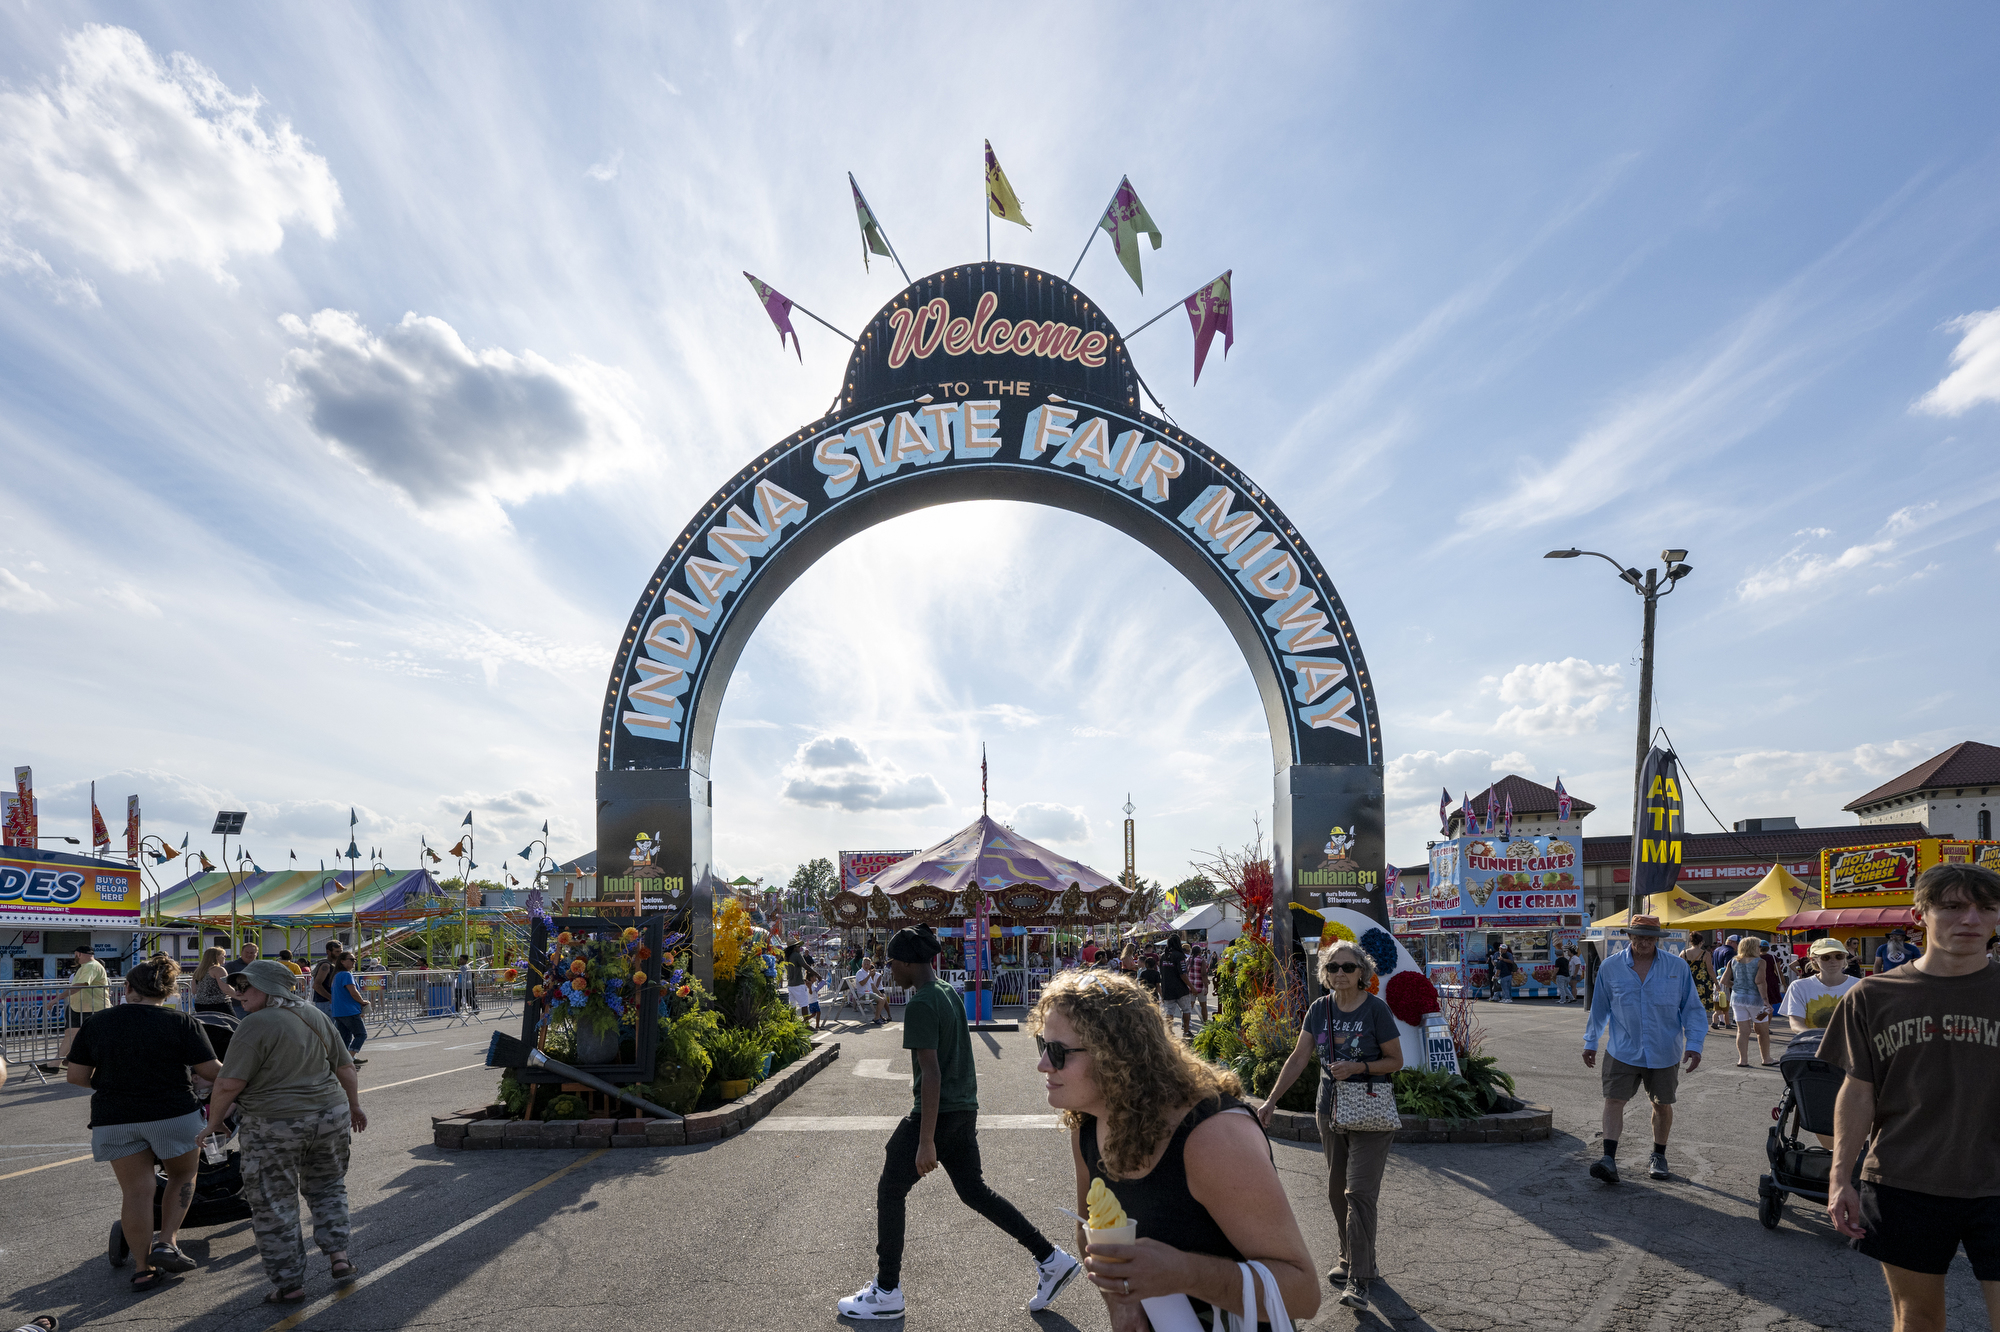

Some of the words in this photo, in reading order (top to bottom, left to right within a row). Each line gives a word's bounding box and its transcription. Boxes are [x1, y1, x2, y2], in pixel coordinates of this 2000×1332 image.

[888, 291, 1107, 369] Welcome
[938, 382, 970, 397] TO
[983, 380, 1030, 397] THE
[622, 478, 808, 742] INDIANA
[813, 400, 1002, 499] STATE
[1020, 404, 1185, 503] FAIR
[1177, 485, 1362, 737] MIDWAY
[1842, 853, 1867, 866] HOT
[1984, 848, 2000, 860] HOT
[1468, 855, 1525, 872] FUNNEL
[1527, 853, 1575, 871] CAKES
[1835, 855, 1901, 880] WISCONSIN
[856, 864, 889, 876] DU
[1298, 868, 1357, 885] Indiana
[1358, 870, 1377, 884] 811
[1685, 868, 1713, 878] THE
[1716, 864, 1809, 878] MERCAILE
[1853, 867, 1896, 884] CHEESE
[96, 876, 114, 885] BUY
[115, 877, 128, 886] OR
[664, 876, 684, 891] 811
[1532, 875, 1542, 890] &
[95, 885, 129, 894] RELOAD
[101, 893, 123, 901] HERE
[1431, 899, 1447, 910] FUNNEL
[1447, 896, 1460, 910] CAKES
[1497, 894, 1523, 909] ICE
[1525, 893, 1577, 909] CREAM
[1442, 919, 1451, 927] ICE
[359, 979, 387, 987] ENTRANCE
[951, 971, 966, 982] 14
[1428, 1038, 1453, 1053] IND
[1873, 1015, 1934, 1062] PACIFIC
[1429, 1052, 1455, 1061] STATE
[1430, 1061, 1456, 1072] FAIR
